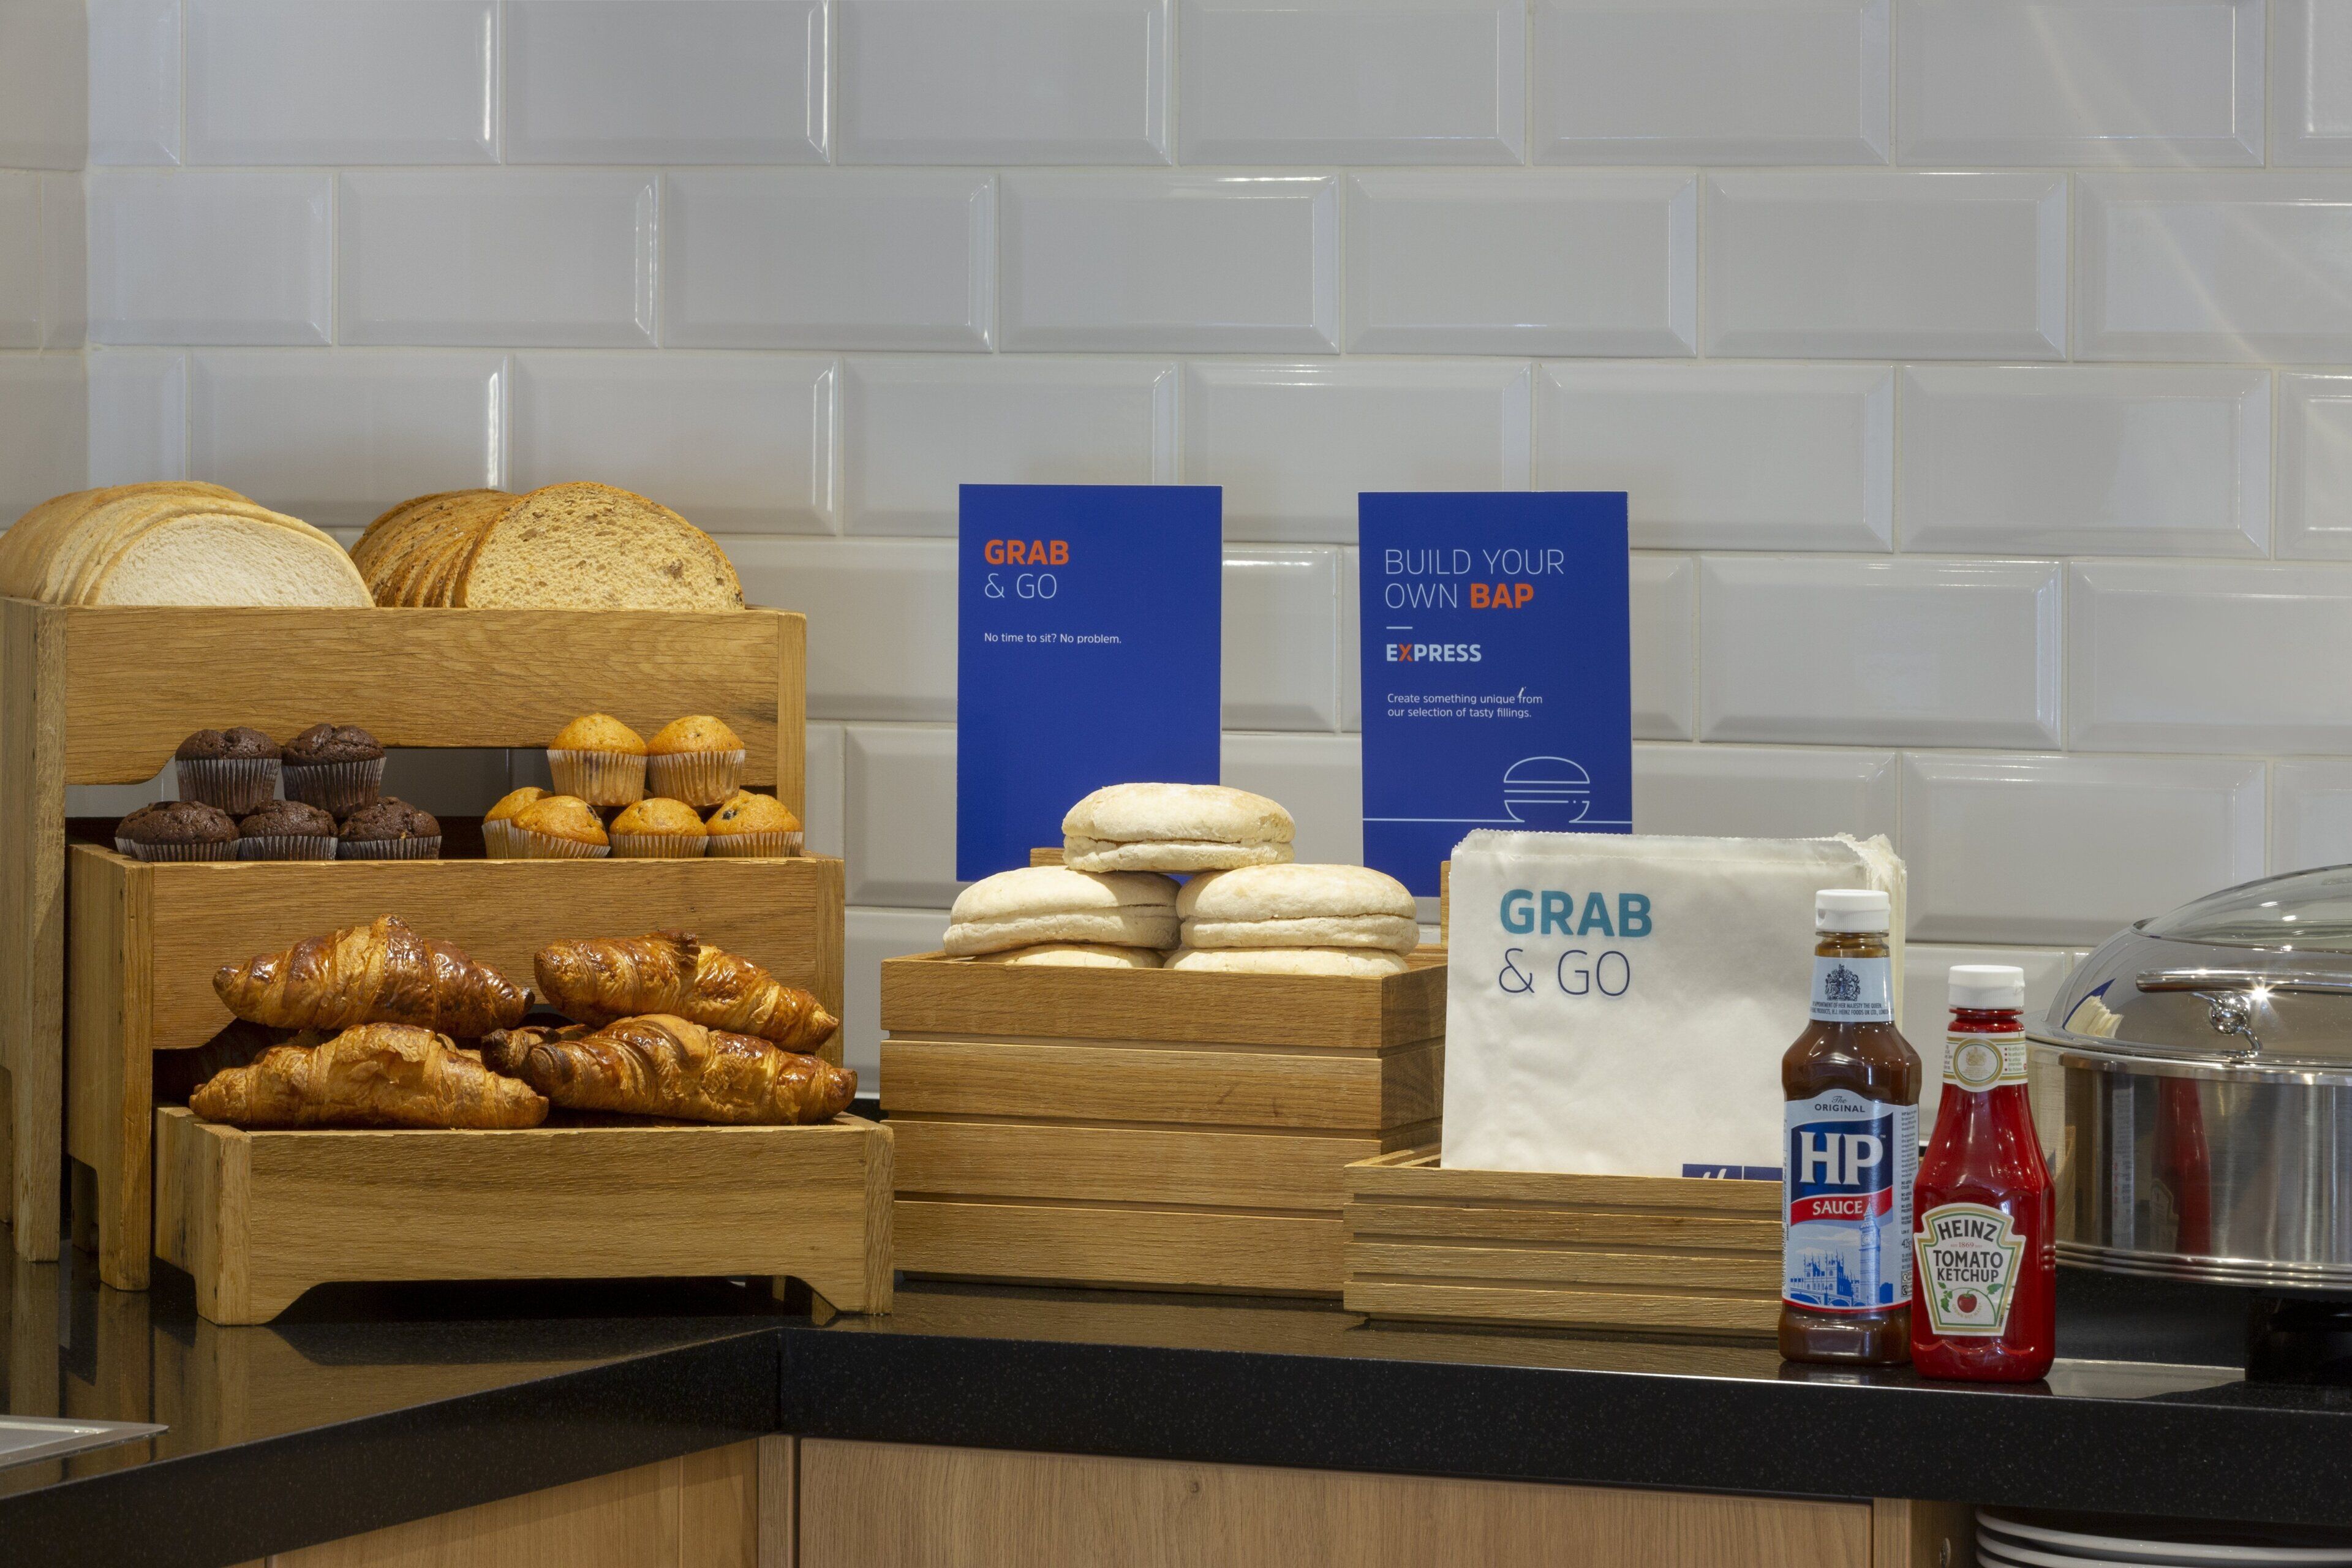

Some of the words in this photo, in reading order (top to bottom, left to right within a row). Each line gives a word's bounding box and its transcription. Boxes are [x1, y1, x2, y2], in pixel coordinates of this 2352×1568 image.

[984, 539, 1069, 565] GRAB
[1385, 549, 1470, 575] BUILD
[1482, 549, 1564, 575] YOUR
[984, 573, 1005, 598] &
[1016, 573, 1057, 598] GO
[1385, 583, 1457, 609] OWN
[1470, 583, 1534, 609] BAP
[984, 633, 998, 643] No
[1001, 633, 1023, 643] time
[1027, 633, 1037, 643] to
[1040, 633, 1057, 643] sit?
[1060, 633, 1074, 643] No
[1077, 634, 1121, 644] problem.
[1386, 643, 1482, 662] EXPRESS
[1387, 693, 1420, 703] Create
[1423, 694, 1477, 704] something
[1480, 695, 1515, 705] unique
[1518, 691, 1543, 704] from
[1408, 707, 1453, 717] selection
[1456, 707, 1466, 717] of
[1470, 708, 1494, 718] tasty
[1497, 707, 1532, 718] fillings.
[1499, 889, 1653, 938] GRAB
[1498, 948, 1536, 993] &
[1557, 949, 1630, 997] GO
[1814, 1103, 1866, 1114] ORIGINAL
[1831, 1095, 1847, 1104] The
[1799, 1131, 1883, 1185] HP
[1812, 1200, 1863, 1216] SAUCE
[1937, 1219, 1998, 1243] HEINZ
[1932, 1250, 2003, 1268] TOMATO
[1937, 1267, 1999, 1283] KETCHUP
